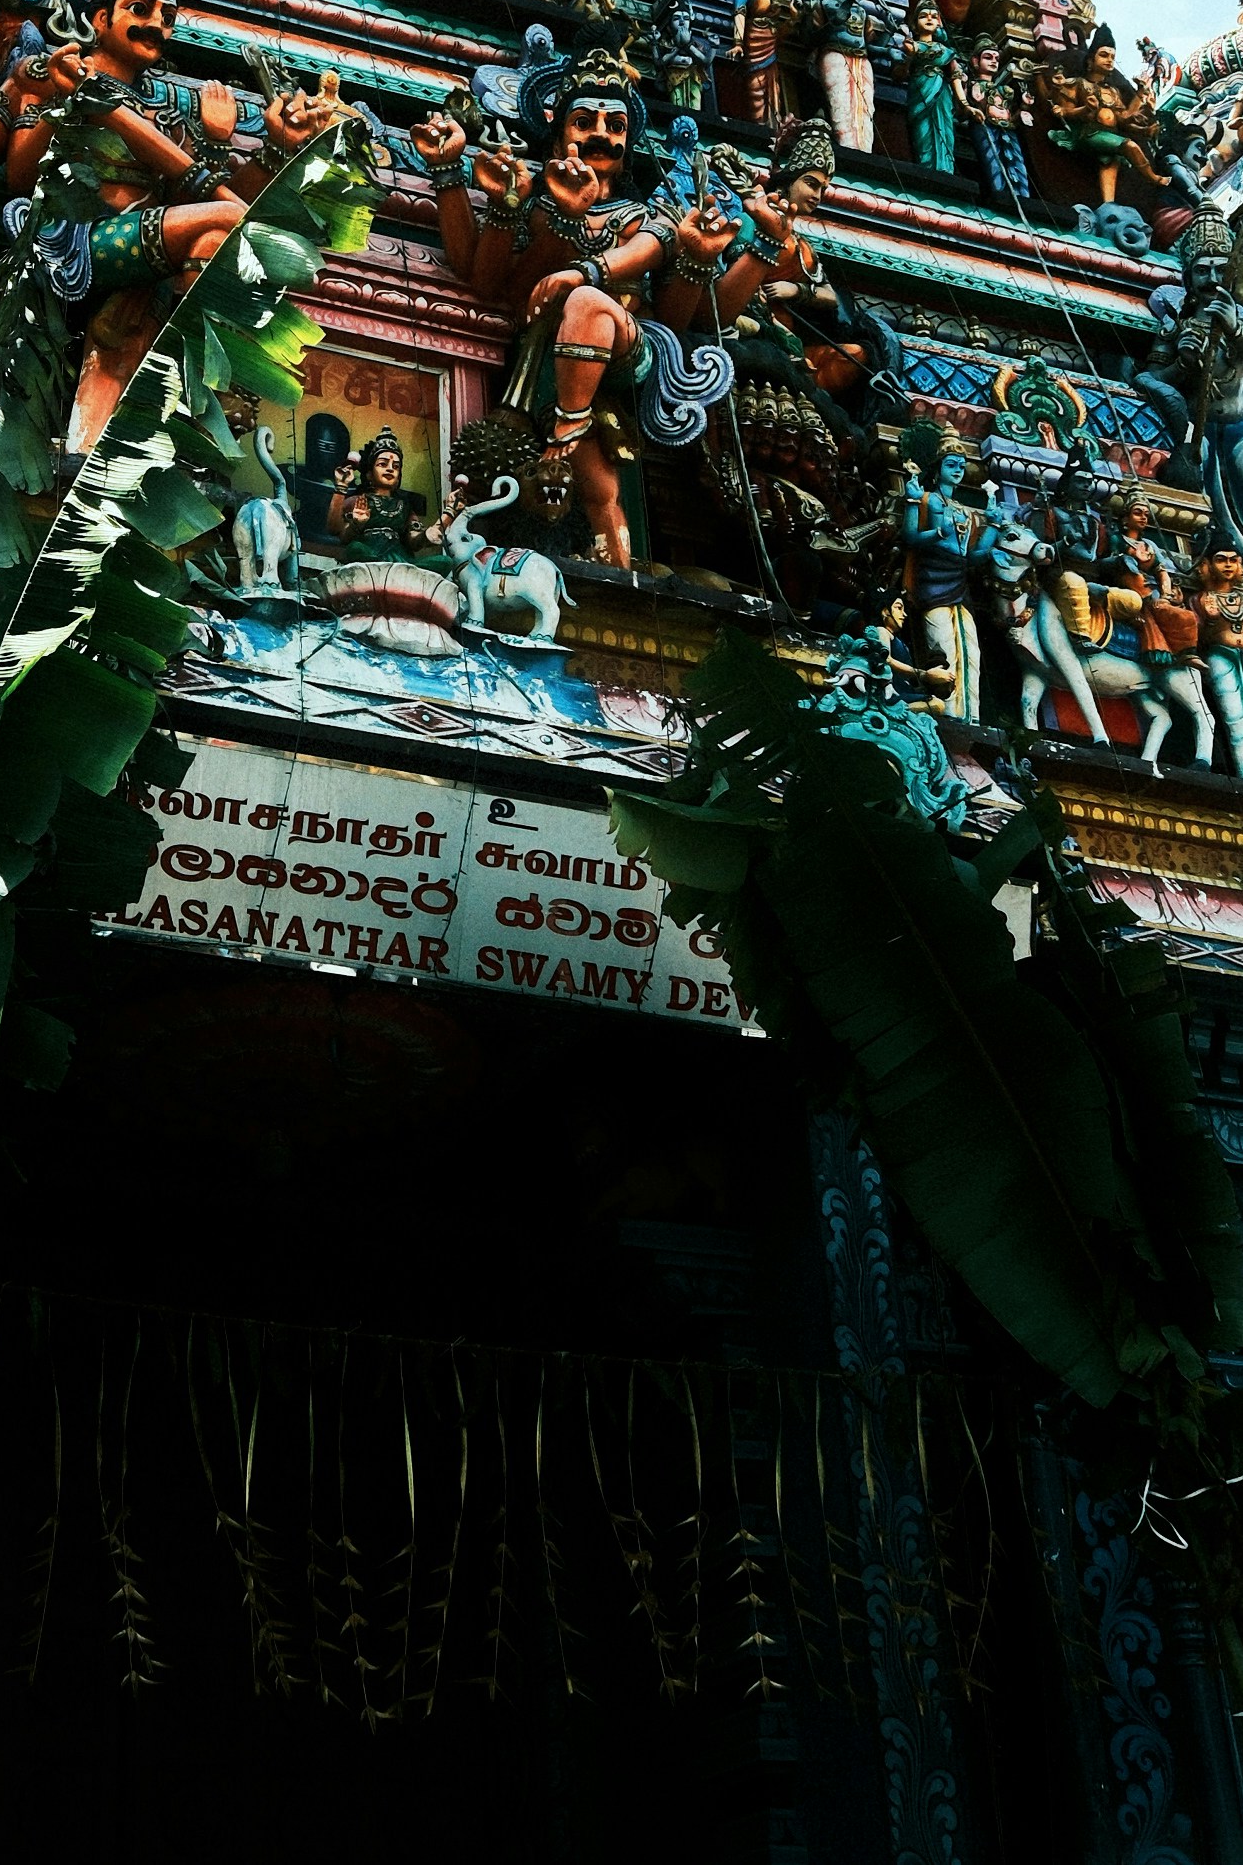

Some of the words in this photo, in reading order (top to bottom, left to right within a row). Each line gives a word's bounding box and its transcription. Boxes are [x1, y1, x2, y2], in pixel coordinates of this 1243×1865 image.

[147, 842, 459, 920] ලාසනාදර්
[90, 893, 451, 975] LASANATHAR
[475, 945, 654, 1005] SWAMY
[666, 975, 754, 1022] DEV
